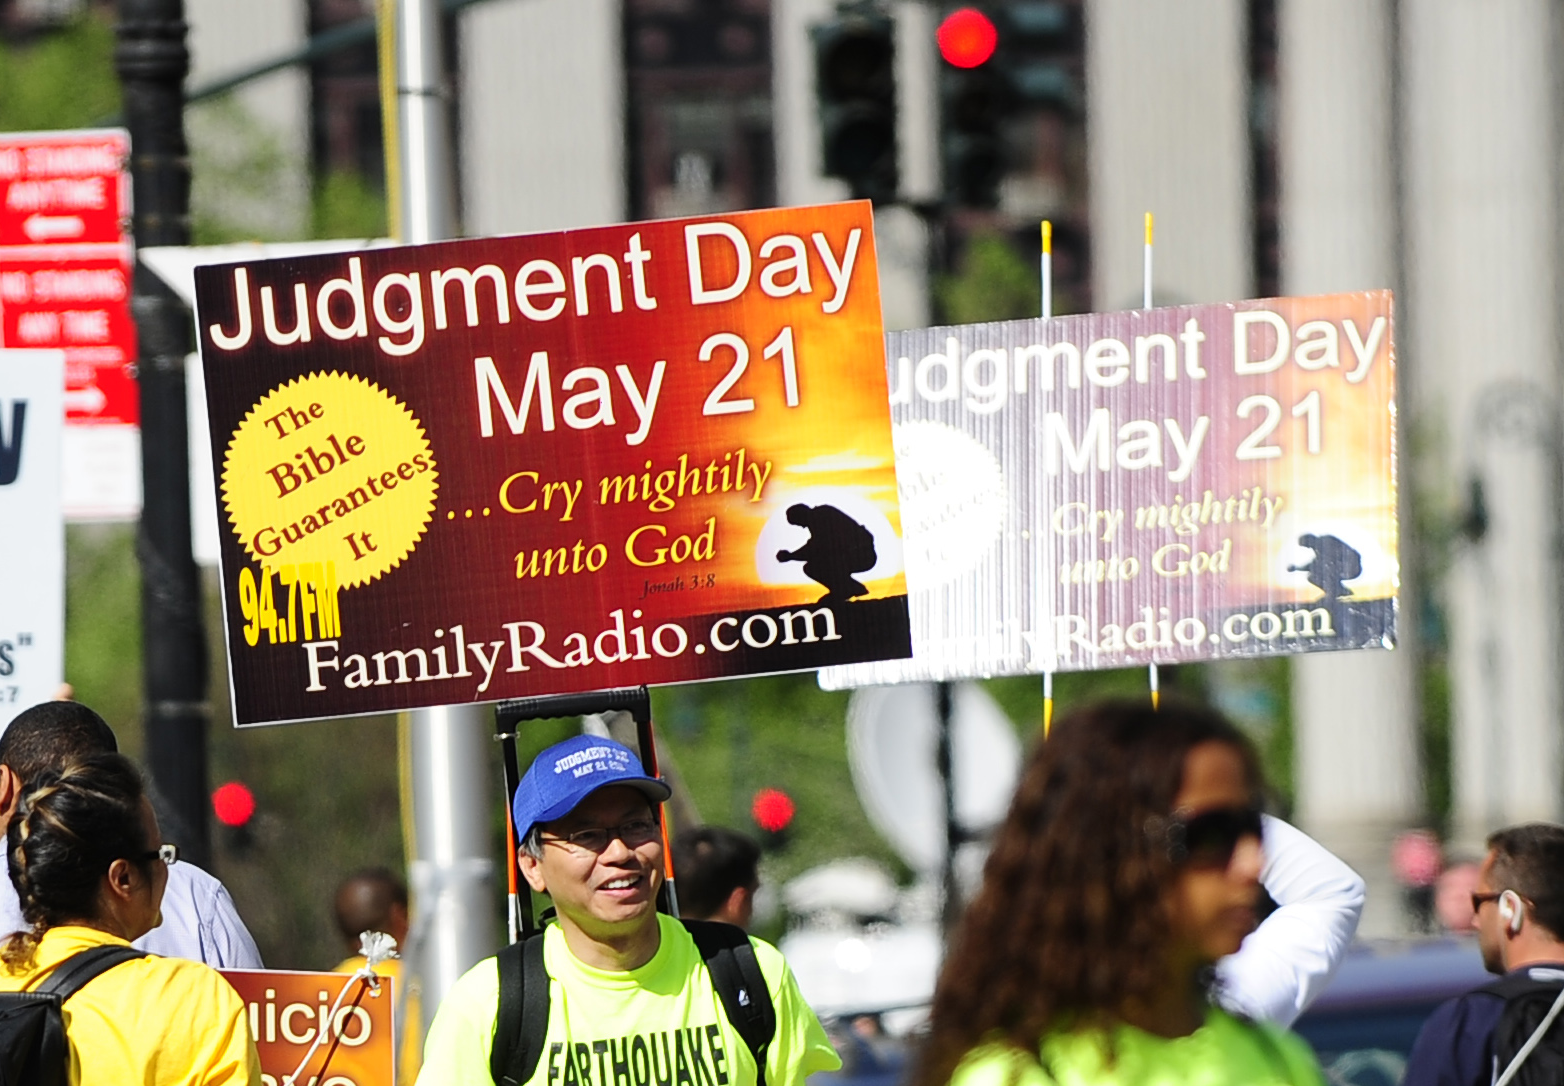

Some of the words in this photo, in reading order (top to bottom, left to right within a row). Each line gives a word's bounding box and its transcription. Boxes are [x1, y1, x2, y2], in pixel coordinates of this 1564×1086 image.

[209, 232, 657, 356] Judgment
[684, 222, 863, 314] Day
[1234, 310, 1386, 383] Day
[264, 398, 325, 443] The
[474, 350, 667, 446] May
[698, 326, 803, 418] 21
[266, 430, 367, 499] Bible
[1046, 408, 1211, 482] May
[1236, 390, 1323, 461] 21
[252, 450, 431, 559] Guarantees
[598, 446, 773, 512] mightily
[1135, 485, 1285, 535] mightily
[344, 531, 379, 564] It
[513, 536, 608, 582] unto
[624, 515, 719, 570] God
[1058, 553, 1140, 585] unto
[1152, 538, 1233, 576] God
[238, 561, 342, 647] 94.7FM
[639, 574, 686, 600] Jonah
[689, 572, 717, 592] 3:8
[303, 602, 841, 693] FamilyRadio.com
